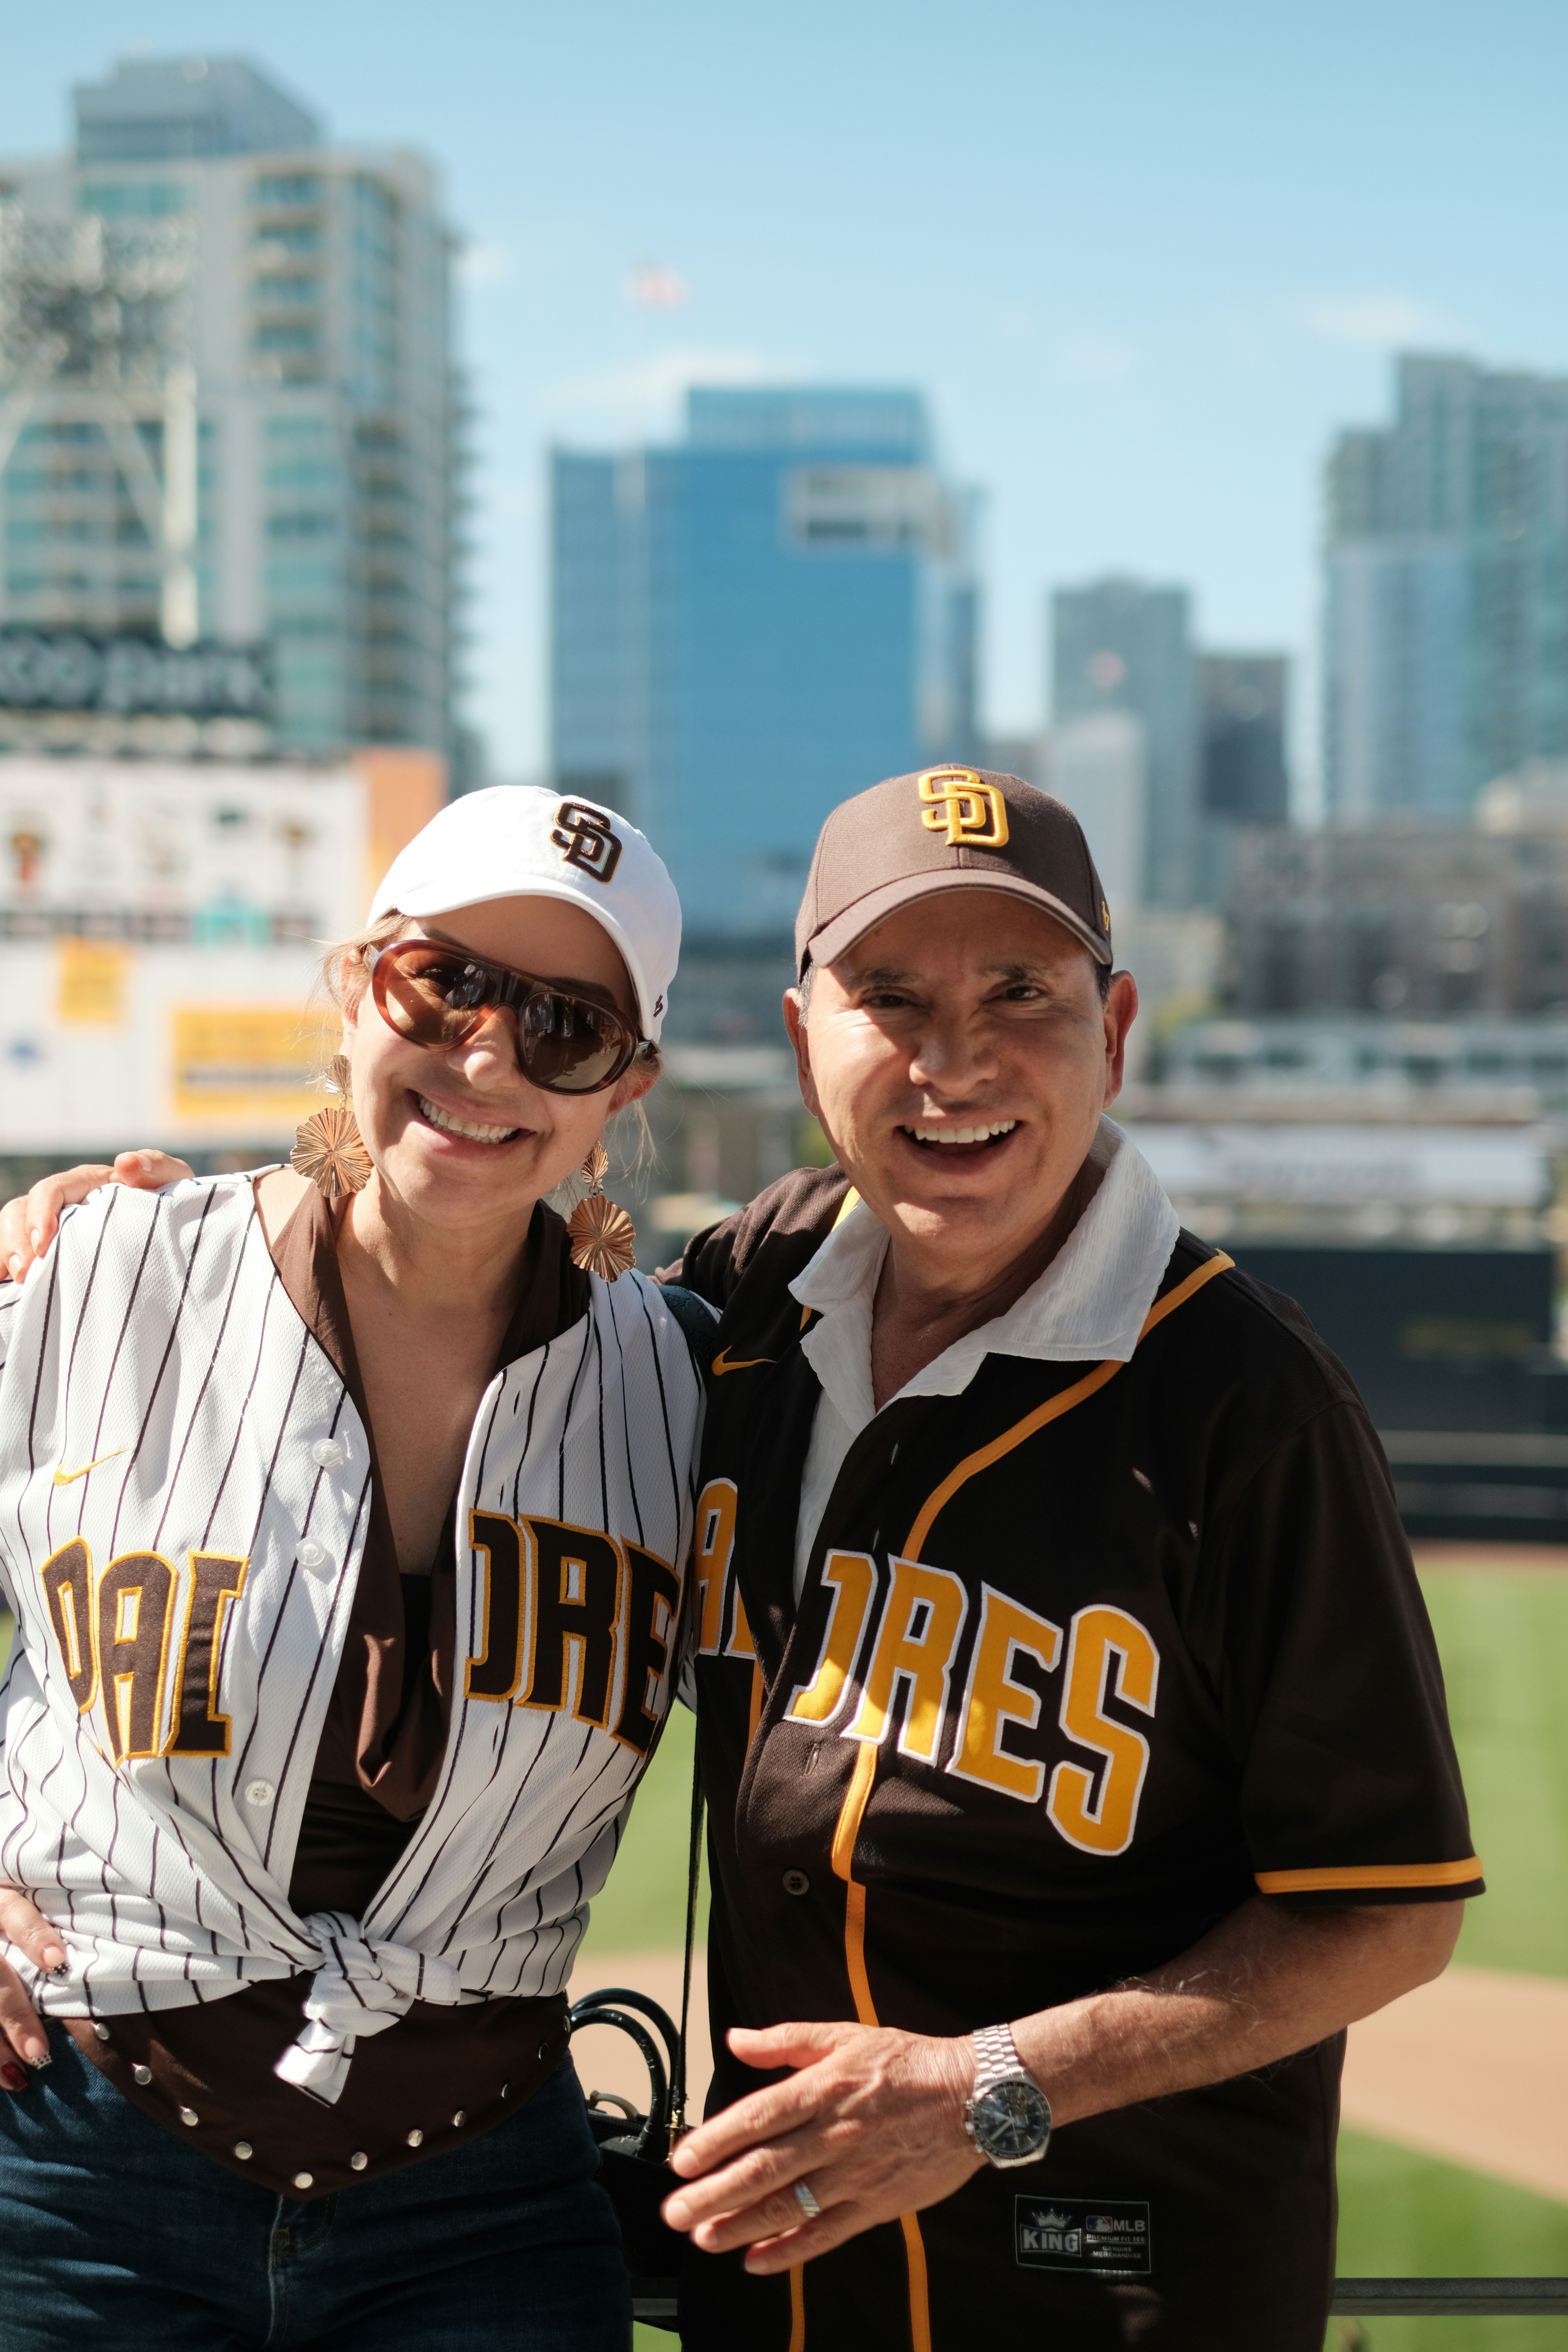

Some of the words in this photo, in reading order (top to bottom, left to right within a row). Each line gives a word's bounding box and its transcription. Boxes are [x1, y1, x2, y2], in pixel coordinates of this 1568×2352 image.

[918, 770, 1009, 847] SD
[549, 801, 623, 885] SD
[1023, 2228, 1079, 2253] KING
[1113, 2219, 1145, 2232] MLB
